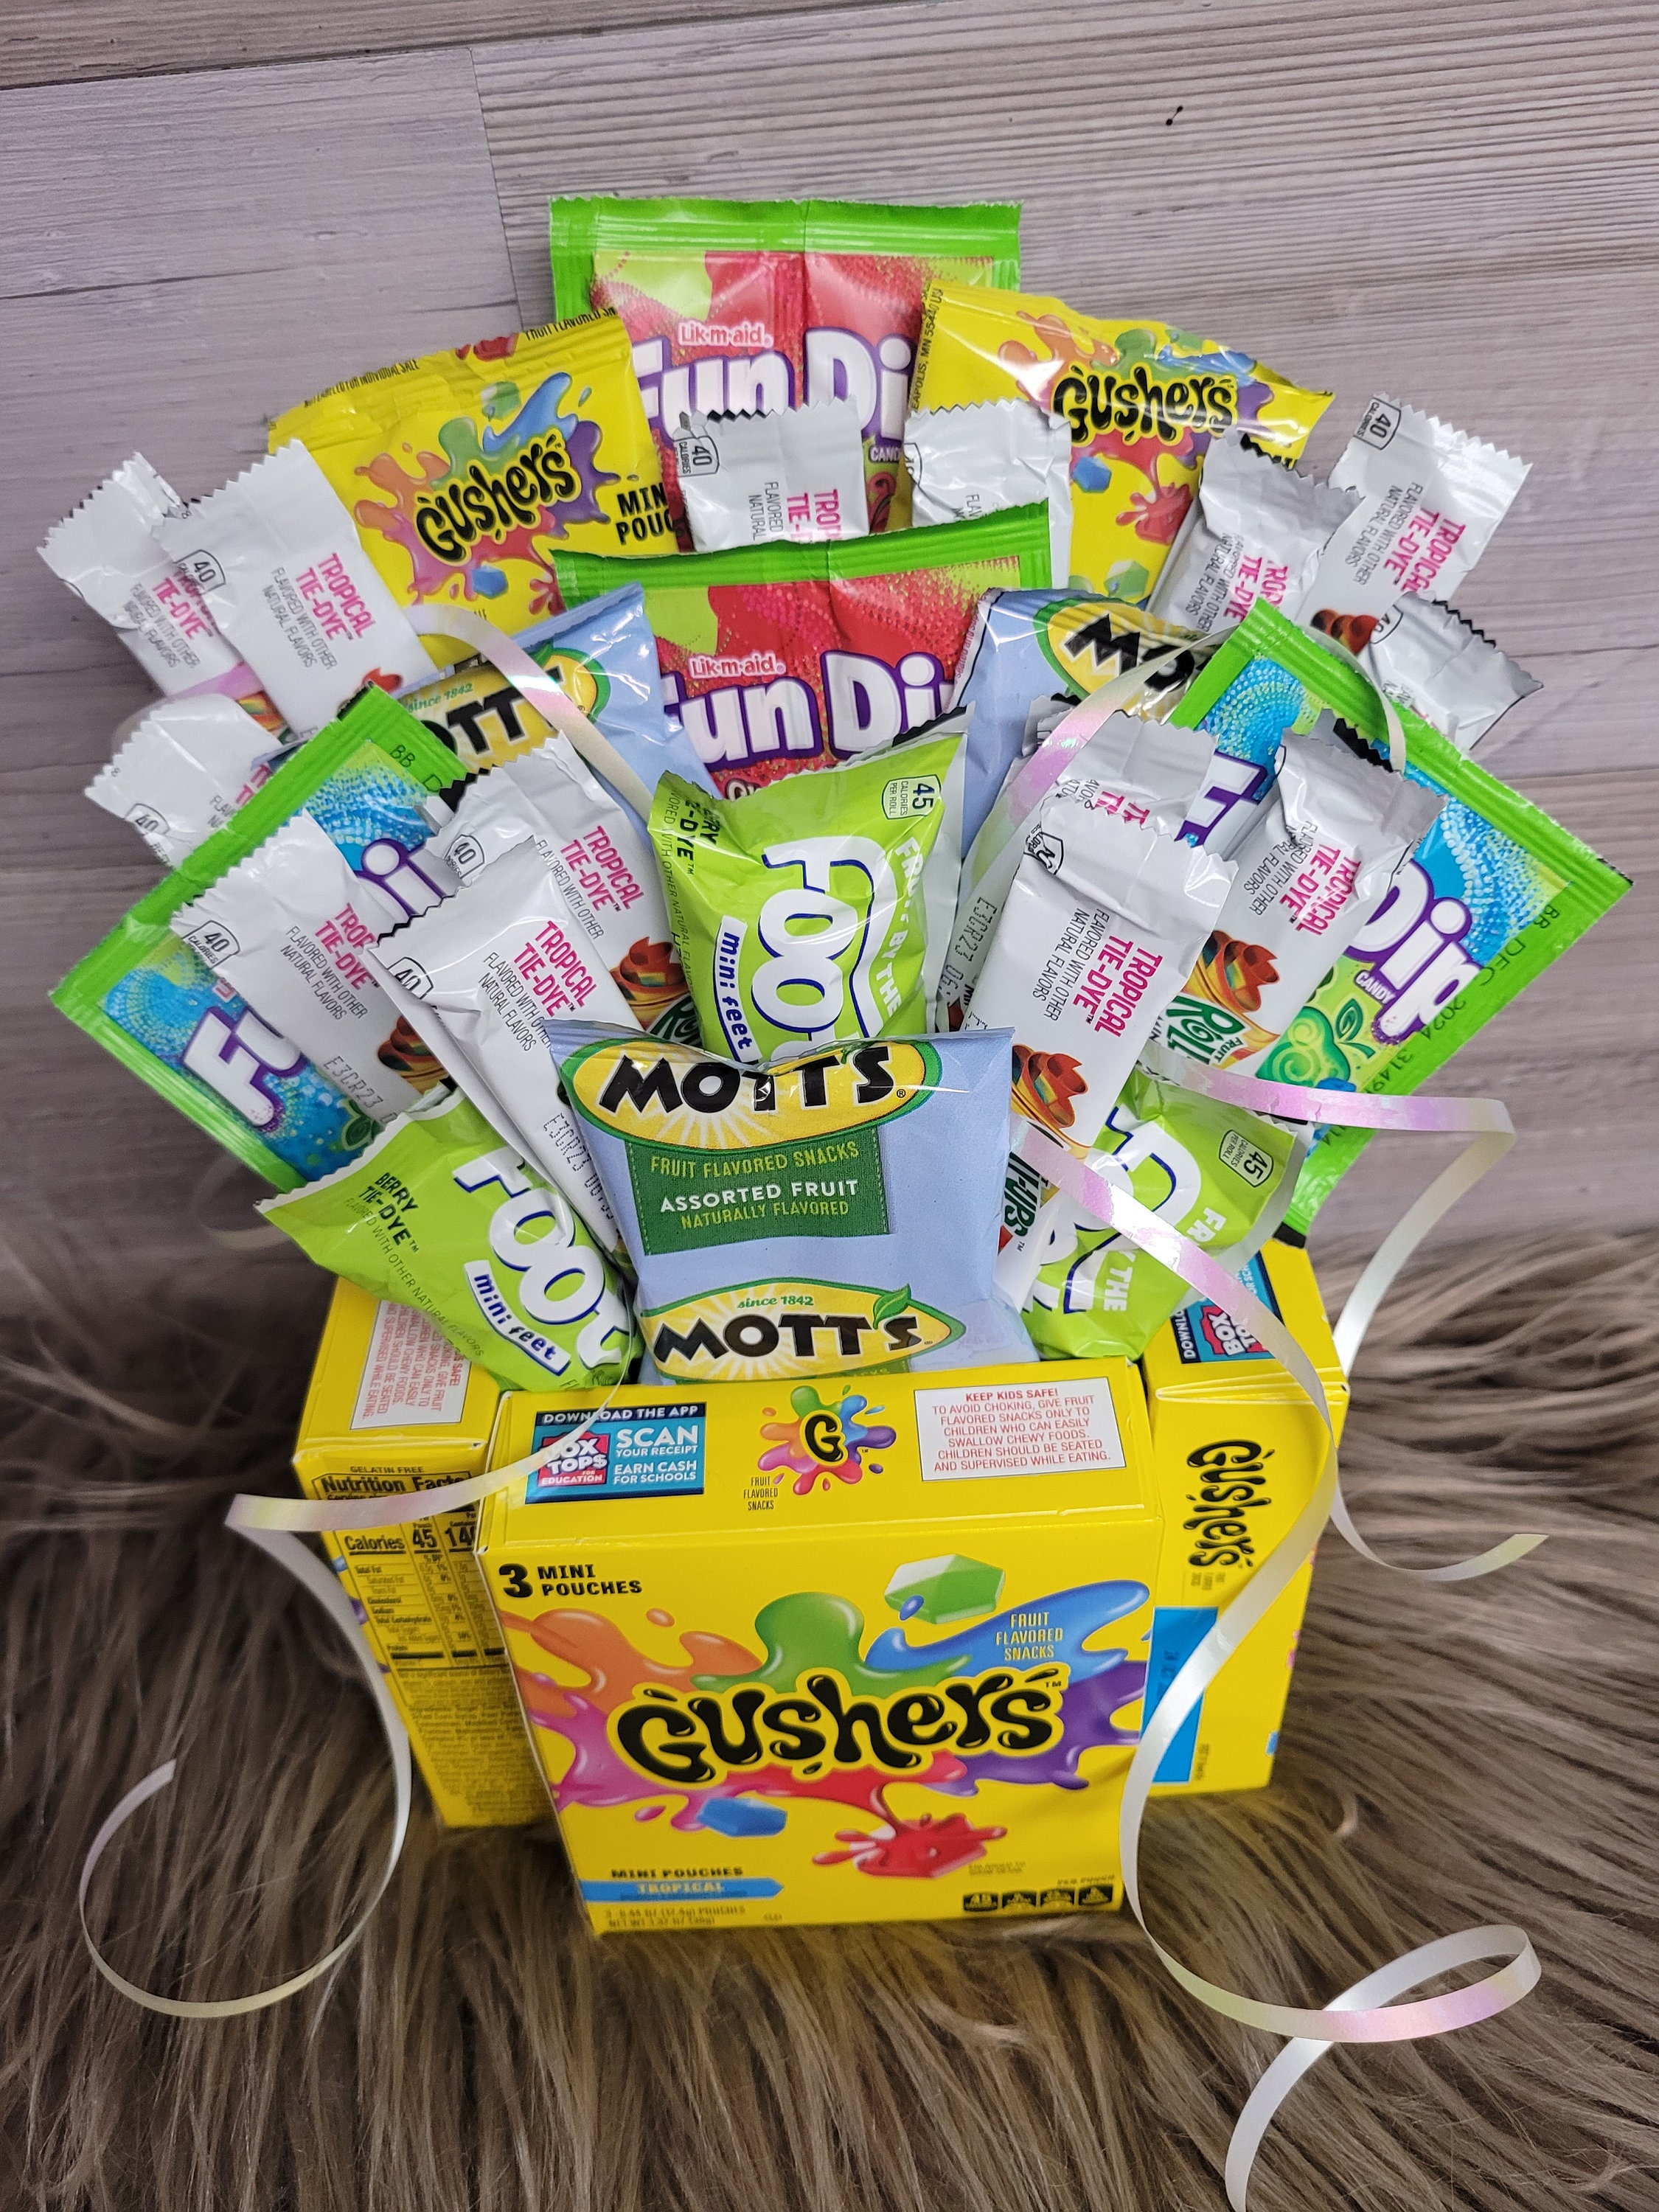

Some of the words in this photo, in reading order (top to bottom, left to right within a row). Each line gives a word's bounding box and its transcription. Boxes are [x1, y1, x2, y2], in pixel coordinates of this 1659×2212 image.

[920, 338, 932, 356] MN
[807, 330, 911, 440] Di
[1054, 365, 1236, 442] Gushers
[1367, 412, 1391, 439] 40
[679, 441, 690, 473] CALORIES
[692, 445, 712, 467] 40
[417, 434, 575, 562] Gushers
[616, 483, 667, 517] MIN
[764, 481, 783, 532] FLAVORED
[1388, 482, 1423, 529] FLAVORED
[748, 494, 765, 540] NATURAL
[190, 556, 217, 584] 40
[1356, 552, 1380, 585] OTHER
[319, 554, 372, 636] TROPICAL
[274, 567, 303, 614] FLAVORED
[311, 639, 336, 666] OTHER
[444, 683, 473, 701] 1842
[390, 745, 416, 768] BB
[901, 781, 909, 816] CALORIES
[913, 783, 933, 810] 45
[454, 842, 476, 863] 40
[584, 827, 643, 908] TROPICAL
[1243, 852, 1279, 894] FLAVORS
[1271, 860, 1297, 888] WITH
[563, 883, 585, 909] WITH
[577, 908, 604, 939] OTHER
[1248, 883, 1278, 915] OTHER
[1296, 858, 1362, 934] TROPICAL
[1054, 908, 1090, 953] NATURAL
[1534, 905, 1559, 928] BB
[204, 932, 229, 951] 40
[1076, 908, 1110, 960] FLAVORED
[286, 925, 327, 969] FLAVORED
[321, 966, 343, 992] WITH
[337, 990, 367, 1018] OTHER
[536, 922, 595, 1005] TROPICAL
[719, 931, 740, 990] mini
[1060, 959, 1085, 988] WITH
[1480, 939, 1526, 987] DEC
[280, 945, 316, 982] NATURAL
[311, 980, 347, 1020] FLAVORS
[484, 952, 524, 997] FLAVORED
[515, 992, 540, 1020] WITH
[877, 961, 902, 1018] THE
[1032, 954, 1065, 1001] FLAVORS
[1095, 949, 1161, 1035] TROPICAL
[1355, 971, 1396, 1004] CANDY
[479, 972, 509, 1014] NATURAL
[502, 1009, 536, 1051] FLAVORS
[1043, 986, 1069, 1020] OTHER
[722, 996, 754, 1051] feet
[1214, 1037, 1244, 1062] FRUIT
[651, 1157, 696, 1178] FRUIT
[703, 1154, 787, 1178] FLAVORED
[793, 1141, 859, 1167] SNACKS
[1244, 1150, 1266, 1179] 45
[375, 1172, 419, 1212] BERRY
[661, 1185, 781, 1212] ASSORTED
[791, 1180, 858, 1197] FRUIT
[682, 1204, 765, 1228] NATURALLY
[774, 1201, 849, 1216] FLAVORED
[389, 1253, 417, 1287] OTHER
[737, 1298, 778, 1309] since
[781, 1296, 814, 1307] 1842
[1103, 1262, 1133, 1311] THE
[475, 1273, 506, 1324] mini
[509, 1326, 555, 1360] feet
[654, 1315, 922, 1362] MOTT'S
[1208, 1312, 1245, 1355] BOX
[933, 1406, 946, 1415] TO
[950, 1404, 981, 1413] AVOID
[985, 1402, 1035, 1412] CHOKING,
[1039, 1399, 1061, 1408] GIVE
[1065, 1395, 1094, 1405] FRUIT
[966, 1392, 993, 1401] KEEP
[998, 1391, 1023, 1399] KIDS
[1027, 1388, 1058, 1397] SAFE!
[543, 1409, 632, 1424] DOWNOAD
[635, 1407, 665, 1418] THE
[669, 1406, 698, 1417] APP
[941, 1414, 995, 1425] FLAVORED
[999, 1411, 1042, 1422] SNACKS
[1046, 1408, 1072, 1418] ONLY
[944, 1425, 997, 1436] CHILDREN
[1001, 1423, 1025, 1432] WHO
[1030, 1422, 1051, 1430] CAN
[1055, 1418, 1090, 1428] EASILY
[616, 1425, 698, 1448] SCAN
[616, 1448, 648, 1457] YOUR
[652, 1445, 698, 1455] RECEIPT
[804, 1414, 844, 1461] G
[938, 1448, 992, 1459] CHILDREN
[996, 1444, 1040, 1455] SHOULD
[1044, 1443, 1057, 1452] BE
[1061, 1439, 1102, 1450] SEATED
[948, 1436, 1003, 1447] SWALLOW
[1007, 1433, 1044, 1444] CHEWY
[1048, 1429, 1089, 1439] FOODS.
[615, 1462, 653, 1475] EARN
[658, 1460, 697, 1472] CASH
[934, 1461, 957, 1472] AND
[961, 1458, 1028, 1470] SUPERVISED
[1032, 1455, 1064, 1465] WHILE
[1069, 1451, 1110, 1462] EATING.
[321, 1477, 405, 1493] Nutrition
[542, 1475, 602, 1484] EDUCATION
[614, 1475, 638, 1484] FOR
[641, 1472, 696, 1483] SCHOOLS
[744, 1487, 778, 1498] FLAVORED
[751, 1476, 771, 1486] FRUIT
[748, 1500, 774, 1510] SNACKS
[1183, 1439, 1276, 1568] Gushers
[344, 1535, 406, 1550] Calories
[413, 1529, 438, 1548] 45
[499, 1562, 533, 1598] 3
[537, 1565, 596, 1580] MINI
[542, 1580, 642, 1596] POUCHES
[995, 1627, 1064, 1646] FLAVORED
[1010, 1612, 1050, 1630] FRUIT
[1004, 1644, 1054, 1661] SNACKS
[618, 1667, 1062, 1784] Gushers
